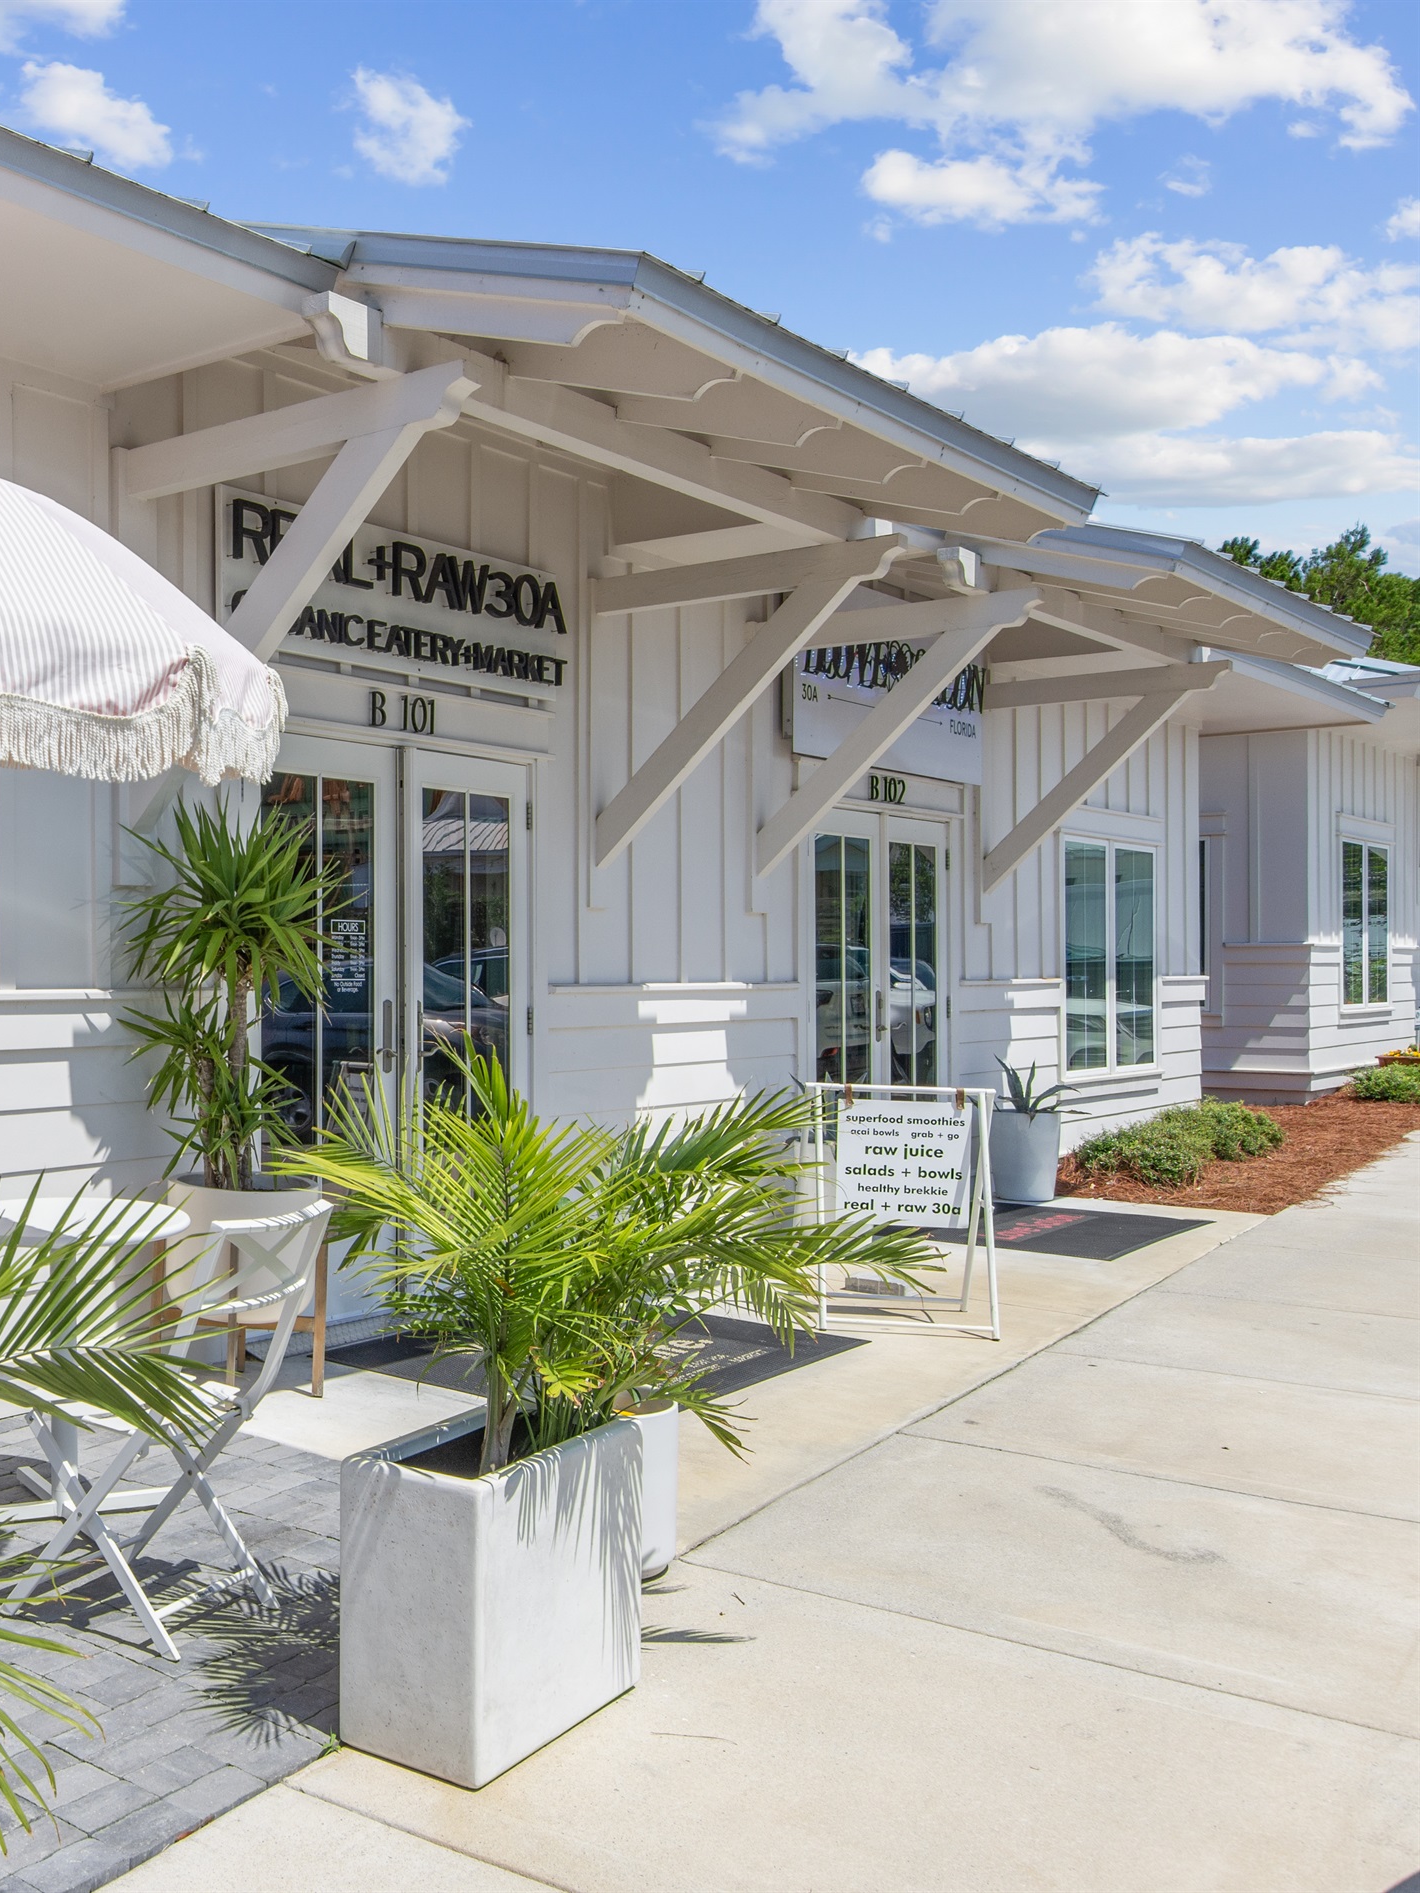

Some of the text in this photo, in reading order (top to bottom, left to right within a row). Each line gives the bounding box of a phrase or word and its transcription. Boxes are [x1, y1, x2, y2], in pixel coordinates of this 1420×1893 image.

[231, 589, 366, 647] ANIC
[369, 690, 436, 735] B 101
[801, 683, 977, 739] 30A FLORIDA
[869, 775, 906, 805] B 102
[337, 922, 359, 932] HOURS
[845, 1113, 965, 1127] superfood smoothies
[850, 1128, 870, 1136] acai
[872, 1128, 900, 1137] bowls
[910, 1130, 934, 1139] grab
[947, 1133, 960, 1141] go
[864, 1143, 944, 1160] raw juice
[844, 1163, 963, 1180] salads + bowls
[857, 1182, 949, 1196] healthy brekkie
[844, 1199, 962, 1215] real + raw 30a
